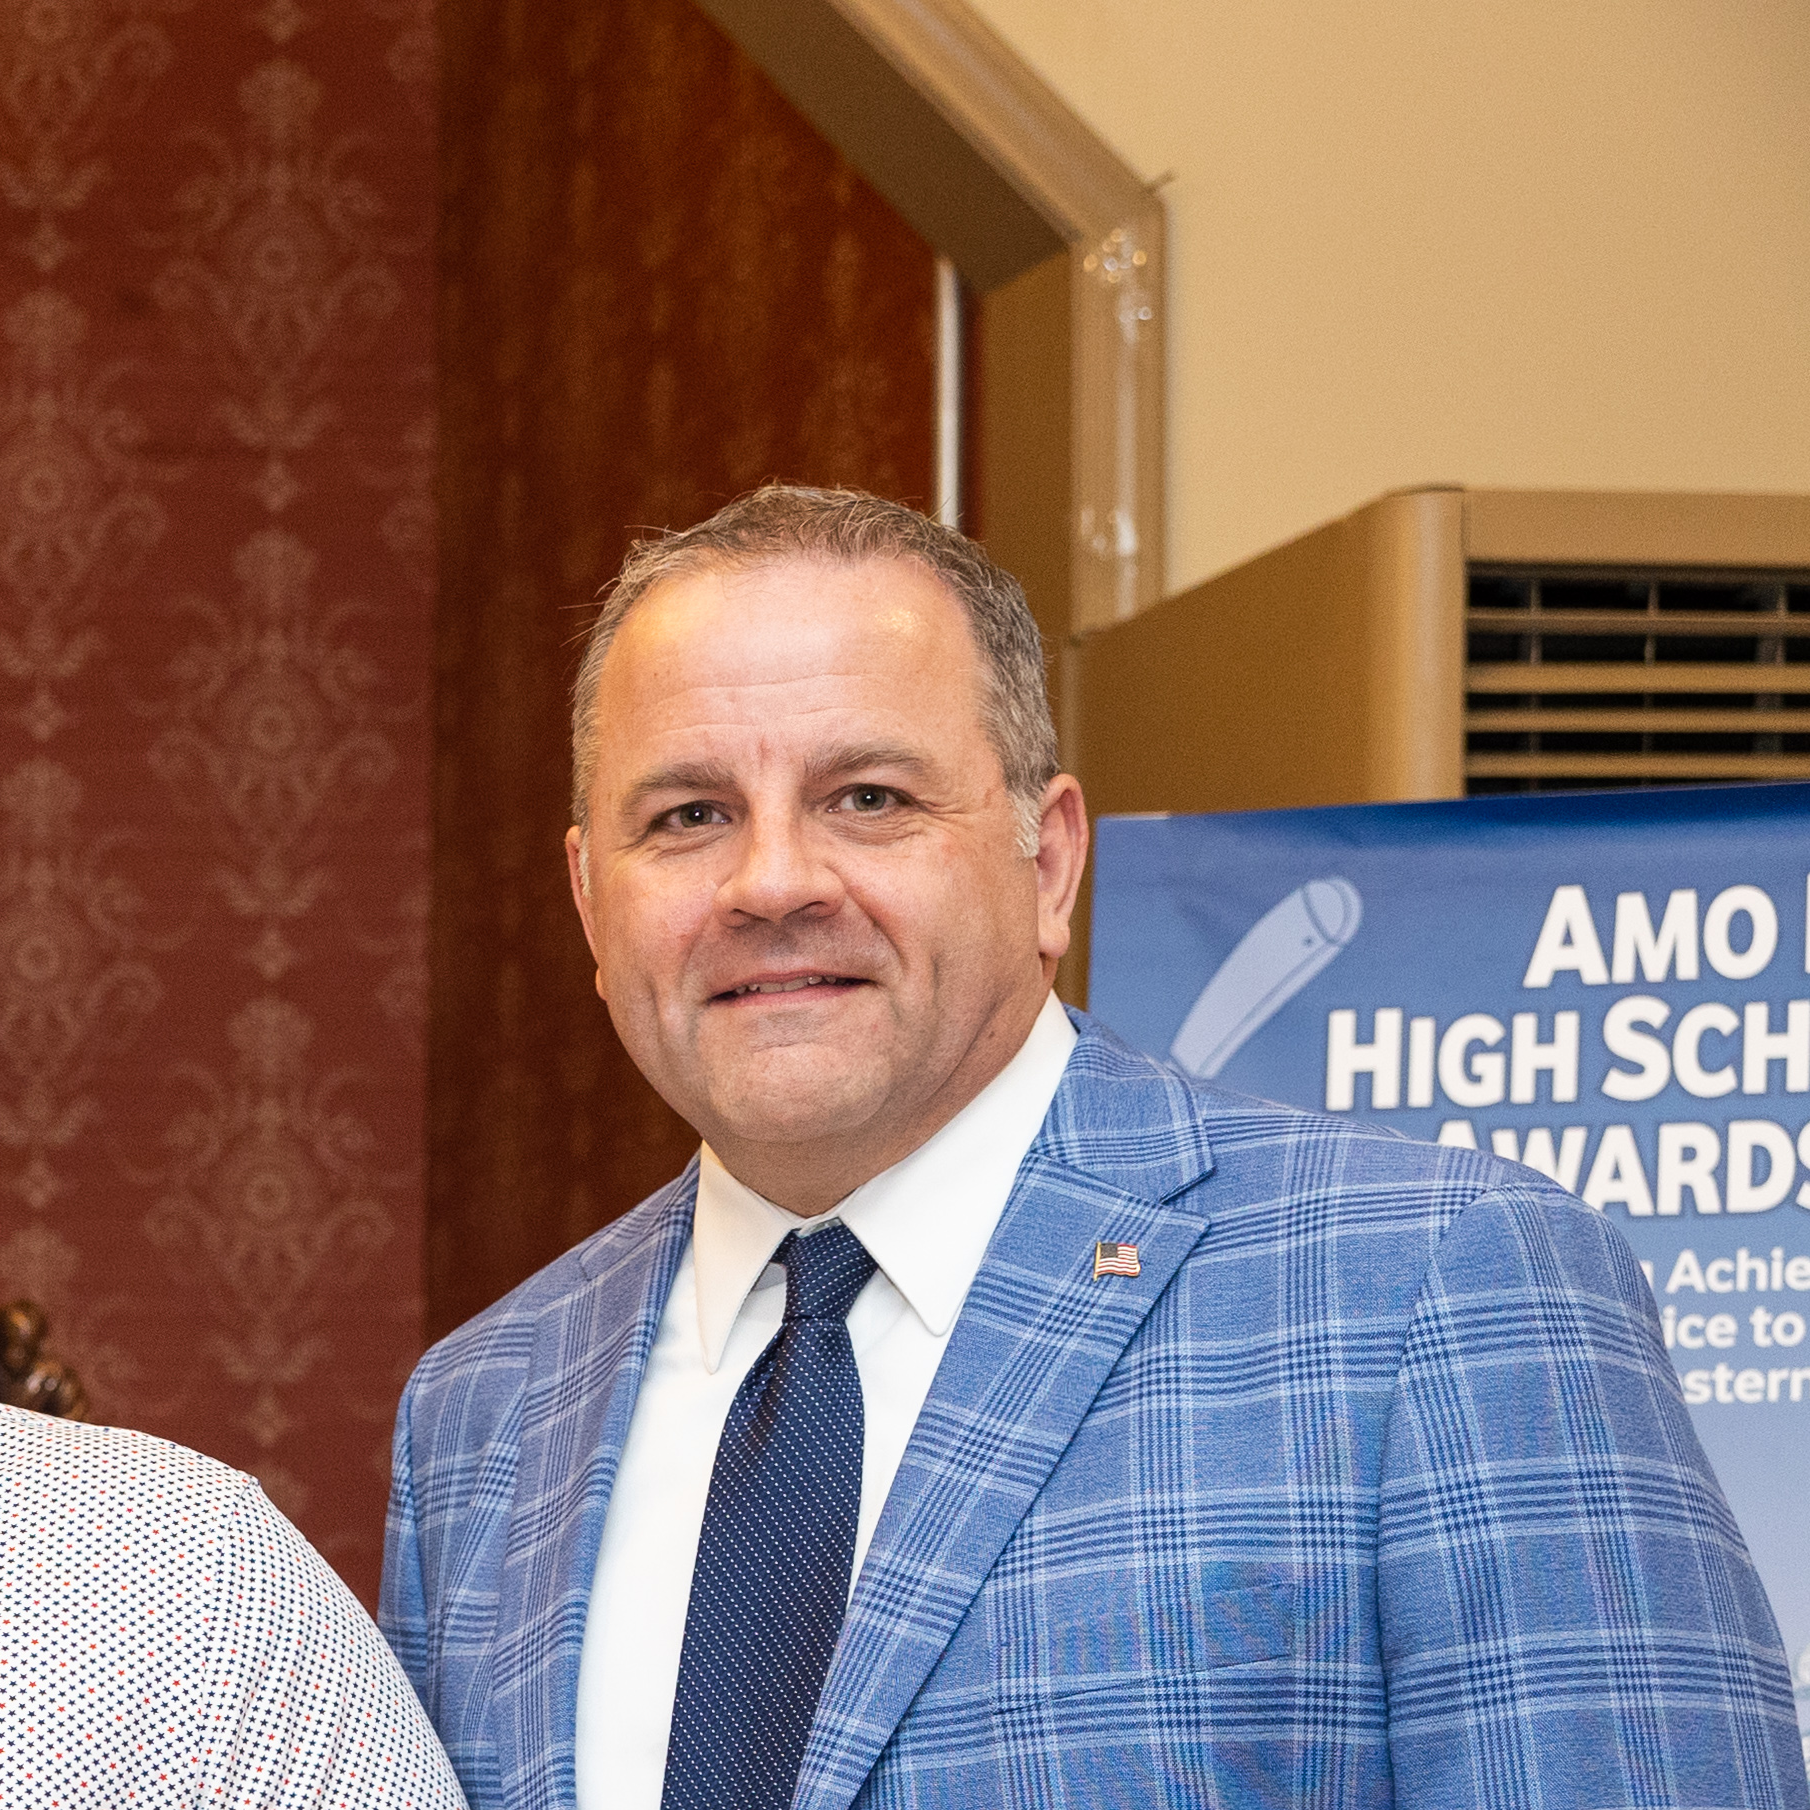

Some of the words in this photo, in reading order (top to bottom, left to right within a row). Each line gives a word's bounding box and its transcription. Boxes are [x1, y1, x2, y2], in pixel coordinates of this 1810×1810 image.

[1522, 884, 1779, 988] AMO
[1325, 1006, 1579, 1112] HIGH
[1600, 994, 1810, 1101] SCH
[1749, 1304, 1807, 1348] to
